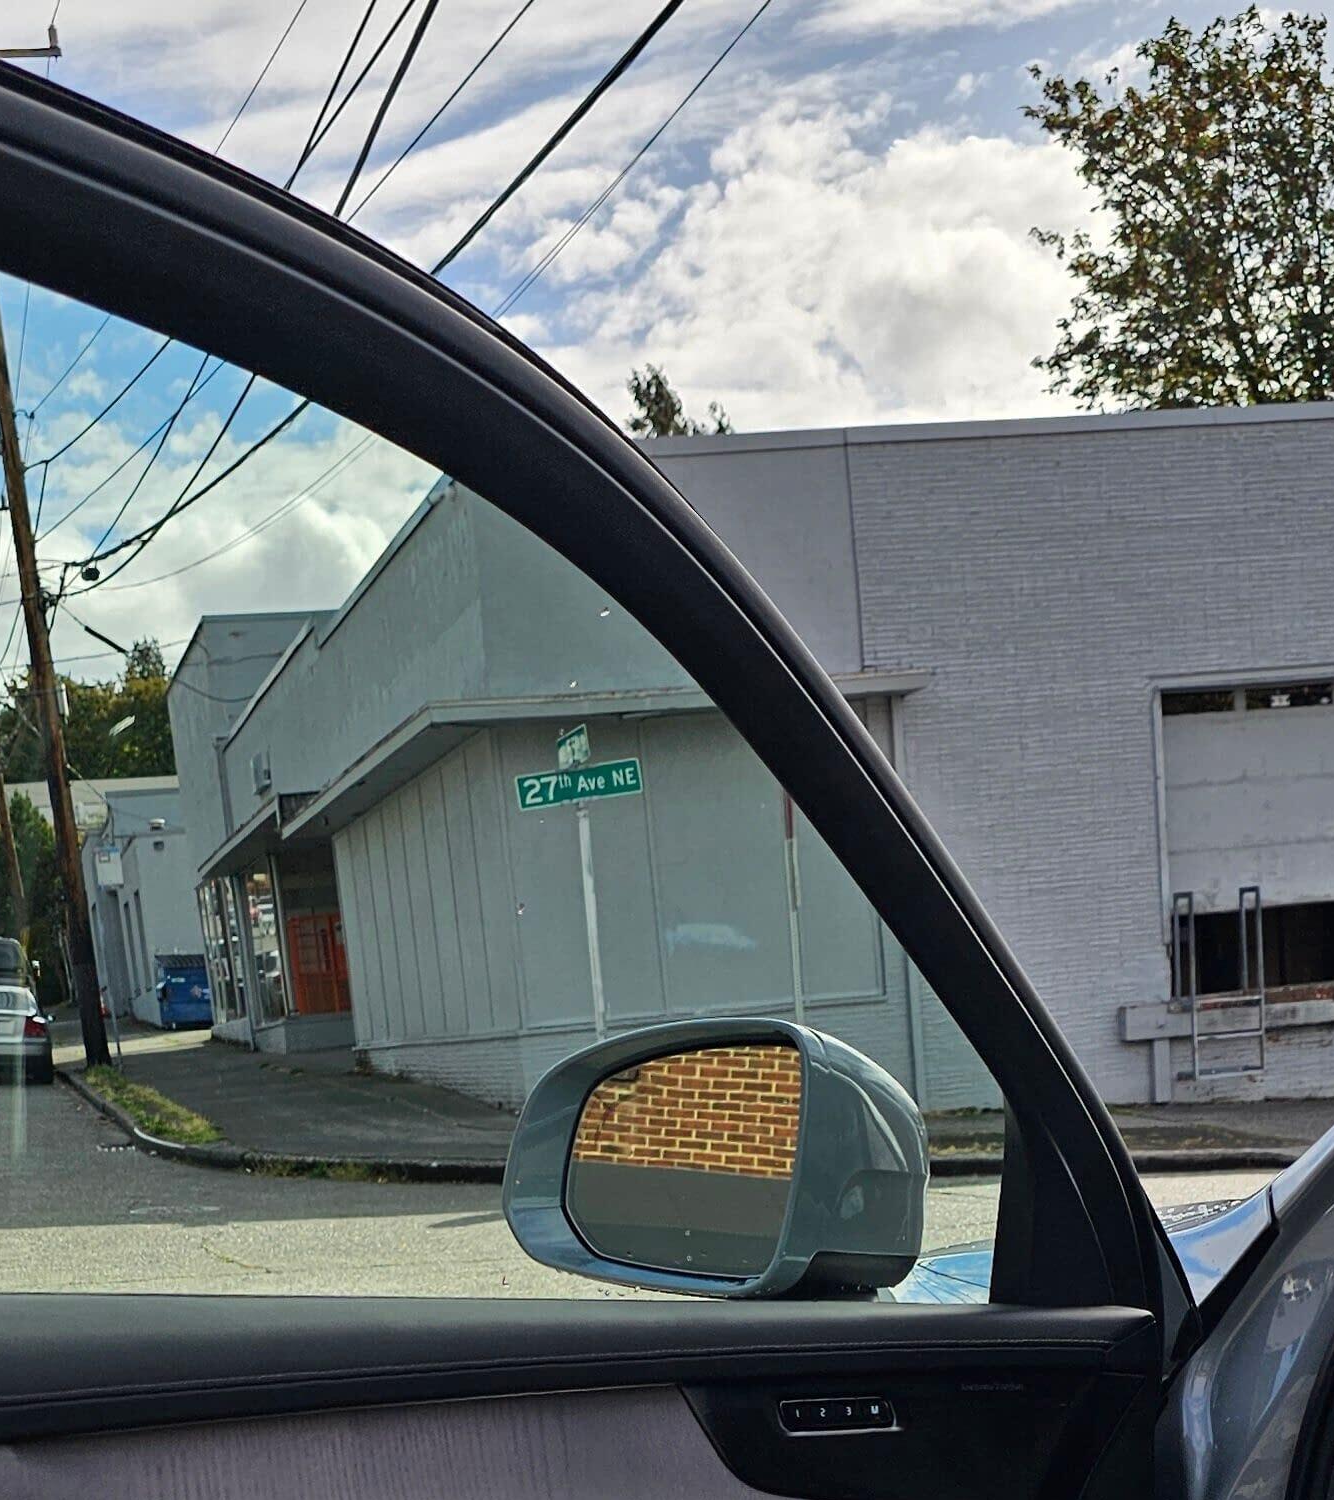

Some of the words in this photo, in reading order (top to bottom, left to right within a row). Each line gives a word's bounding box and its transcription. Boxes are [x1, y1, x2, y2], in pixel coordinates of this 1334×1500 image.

[523, 774, 572, 805] 27th
[577, 776, 605, 793] Ave
[612, 768, 637, 786] NE
